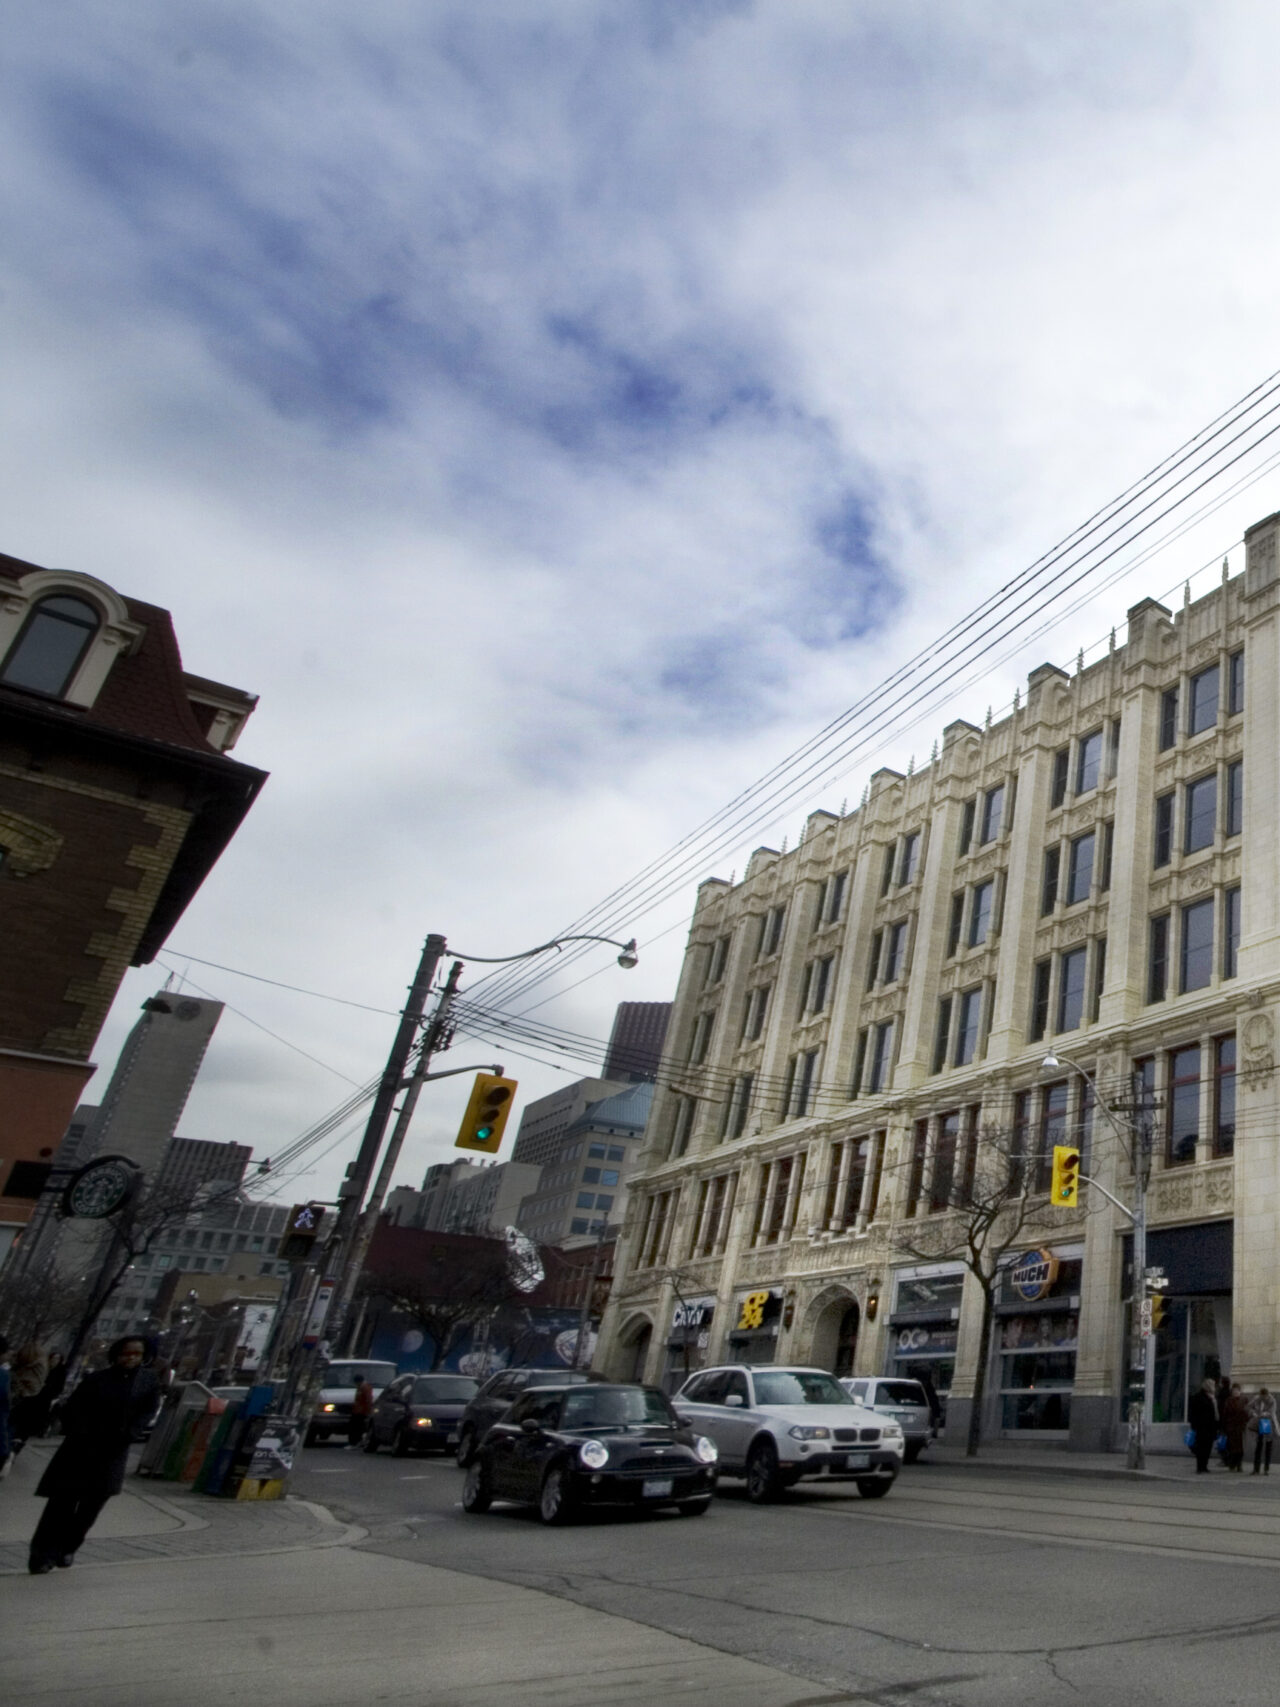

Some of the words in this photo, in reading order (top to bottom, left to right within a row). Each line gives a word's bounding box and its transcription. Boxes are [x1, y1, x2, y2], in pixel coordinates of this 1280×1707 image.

[1013, 1262, 1050, 1282] MUCH
[744, 1292, 769, 1310] CP
[737, 1308, 764, 1330] 24
